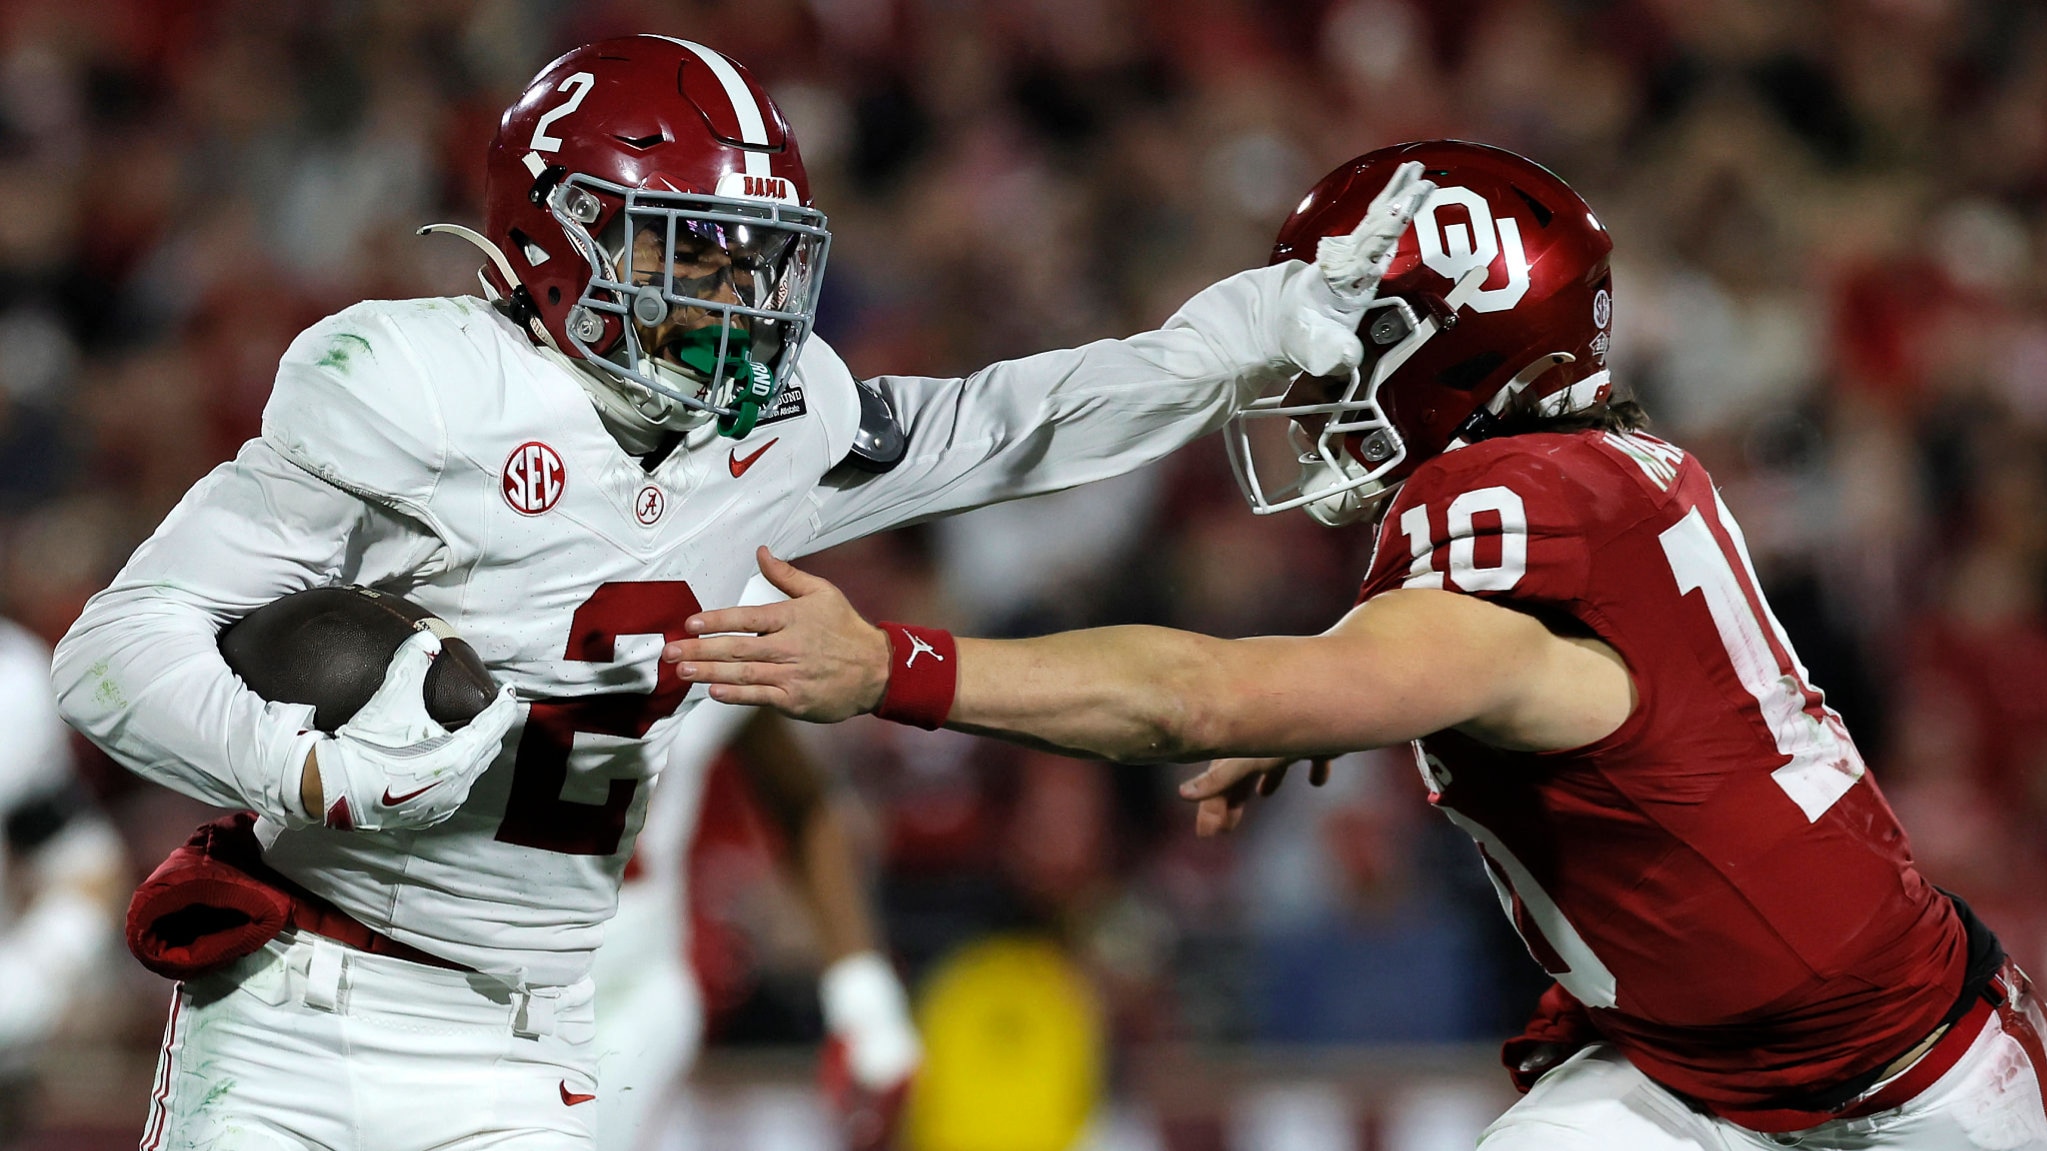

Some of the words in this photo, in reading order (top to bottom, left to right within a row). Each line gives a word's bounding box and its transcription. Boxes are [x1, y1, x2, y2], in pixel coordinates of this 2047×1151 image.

[530, 72, 594, 152] 2
[744, 176, 787, 199] BAMA
[506, 445, 561, 511] SEC
[640, 492, 657, 517] A
[1400, 486, 1527, 592] 10
[494, 580, 703, 856] 2
